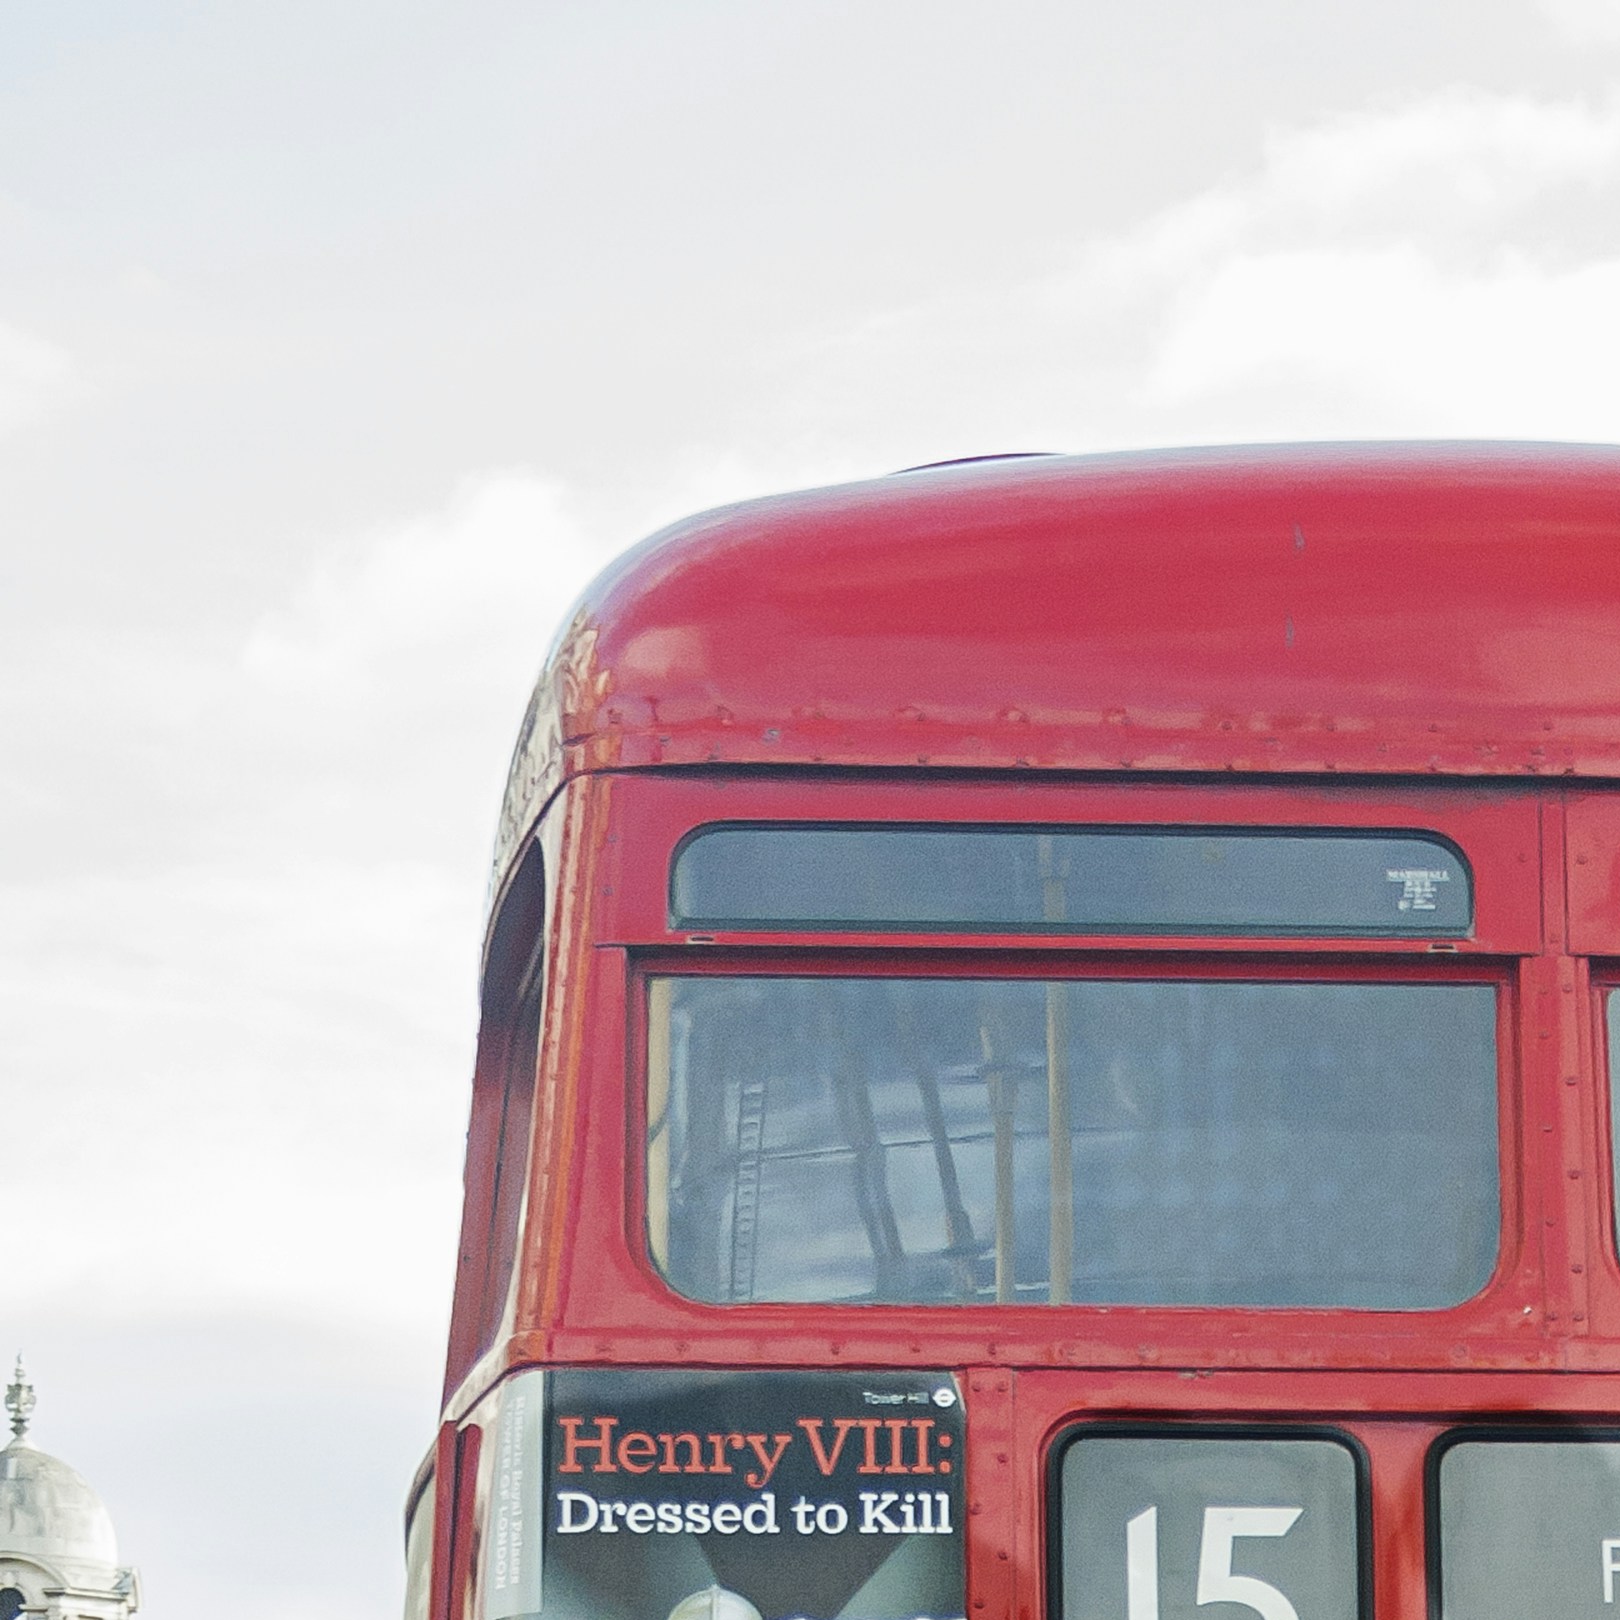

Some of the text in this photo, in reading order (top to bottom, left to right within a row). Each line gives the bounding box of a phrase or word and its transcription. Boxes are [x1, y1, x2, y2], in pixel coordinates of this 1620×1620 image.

[557, 1416, 952, 1488] Henry VIII:
[495, 1506, 508, 1590] LONDON
[557, 1493, 953, 1534] Dressed to Kill
